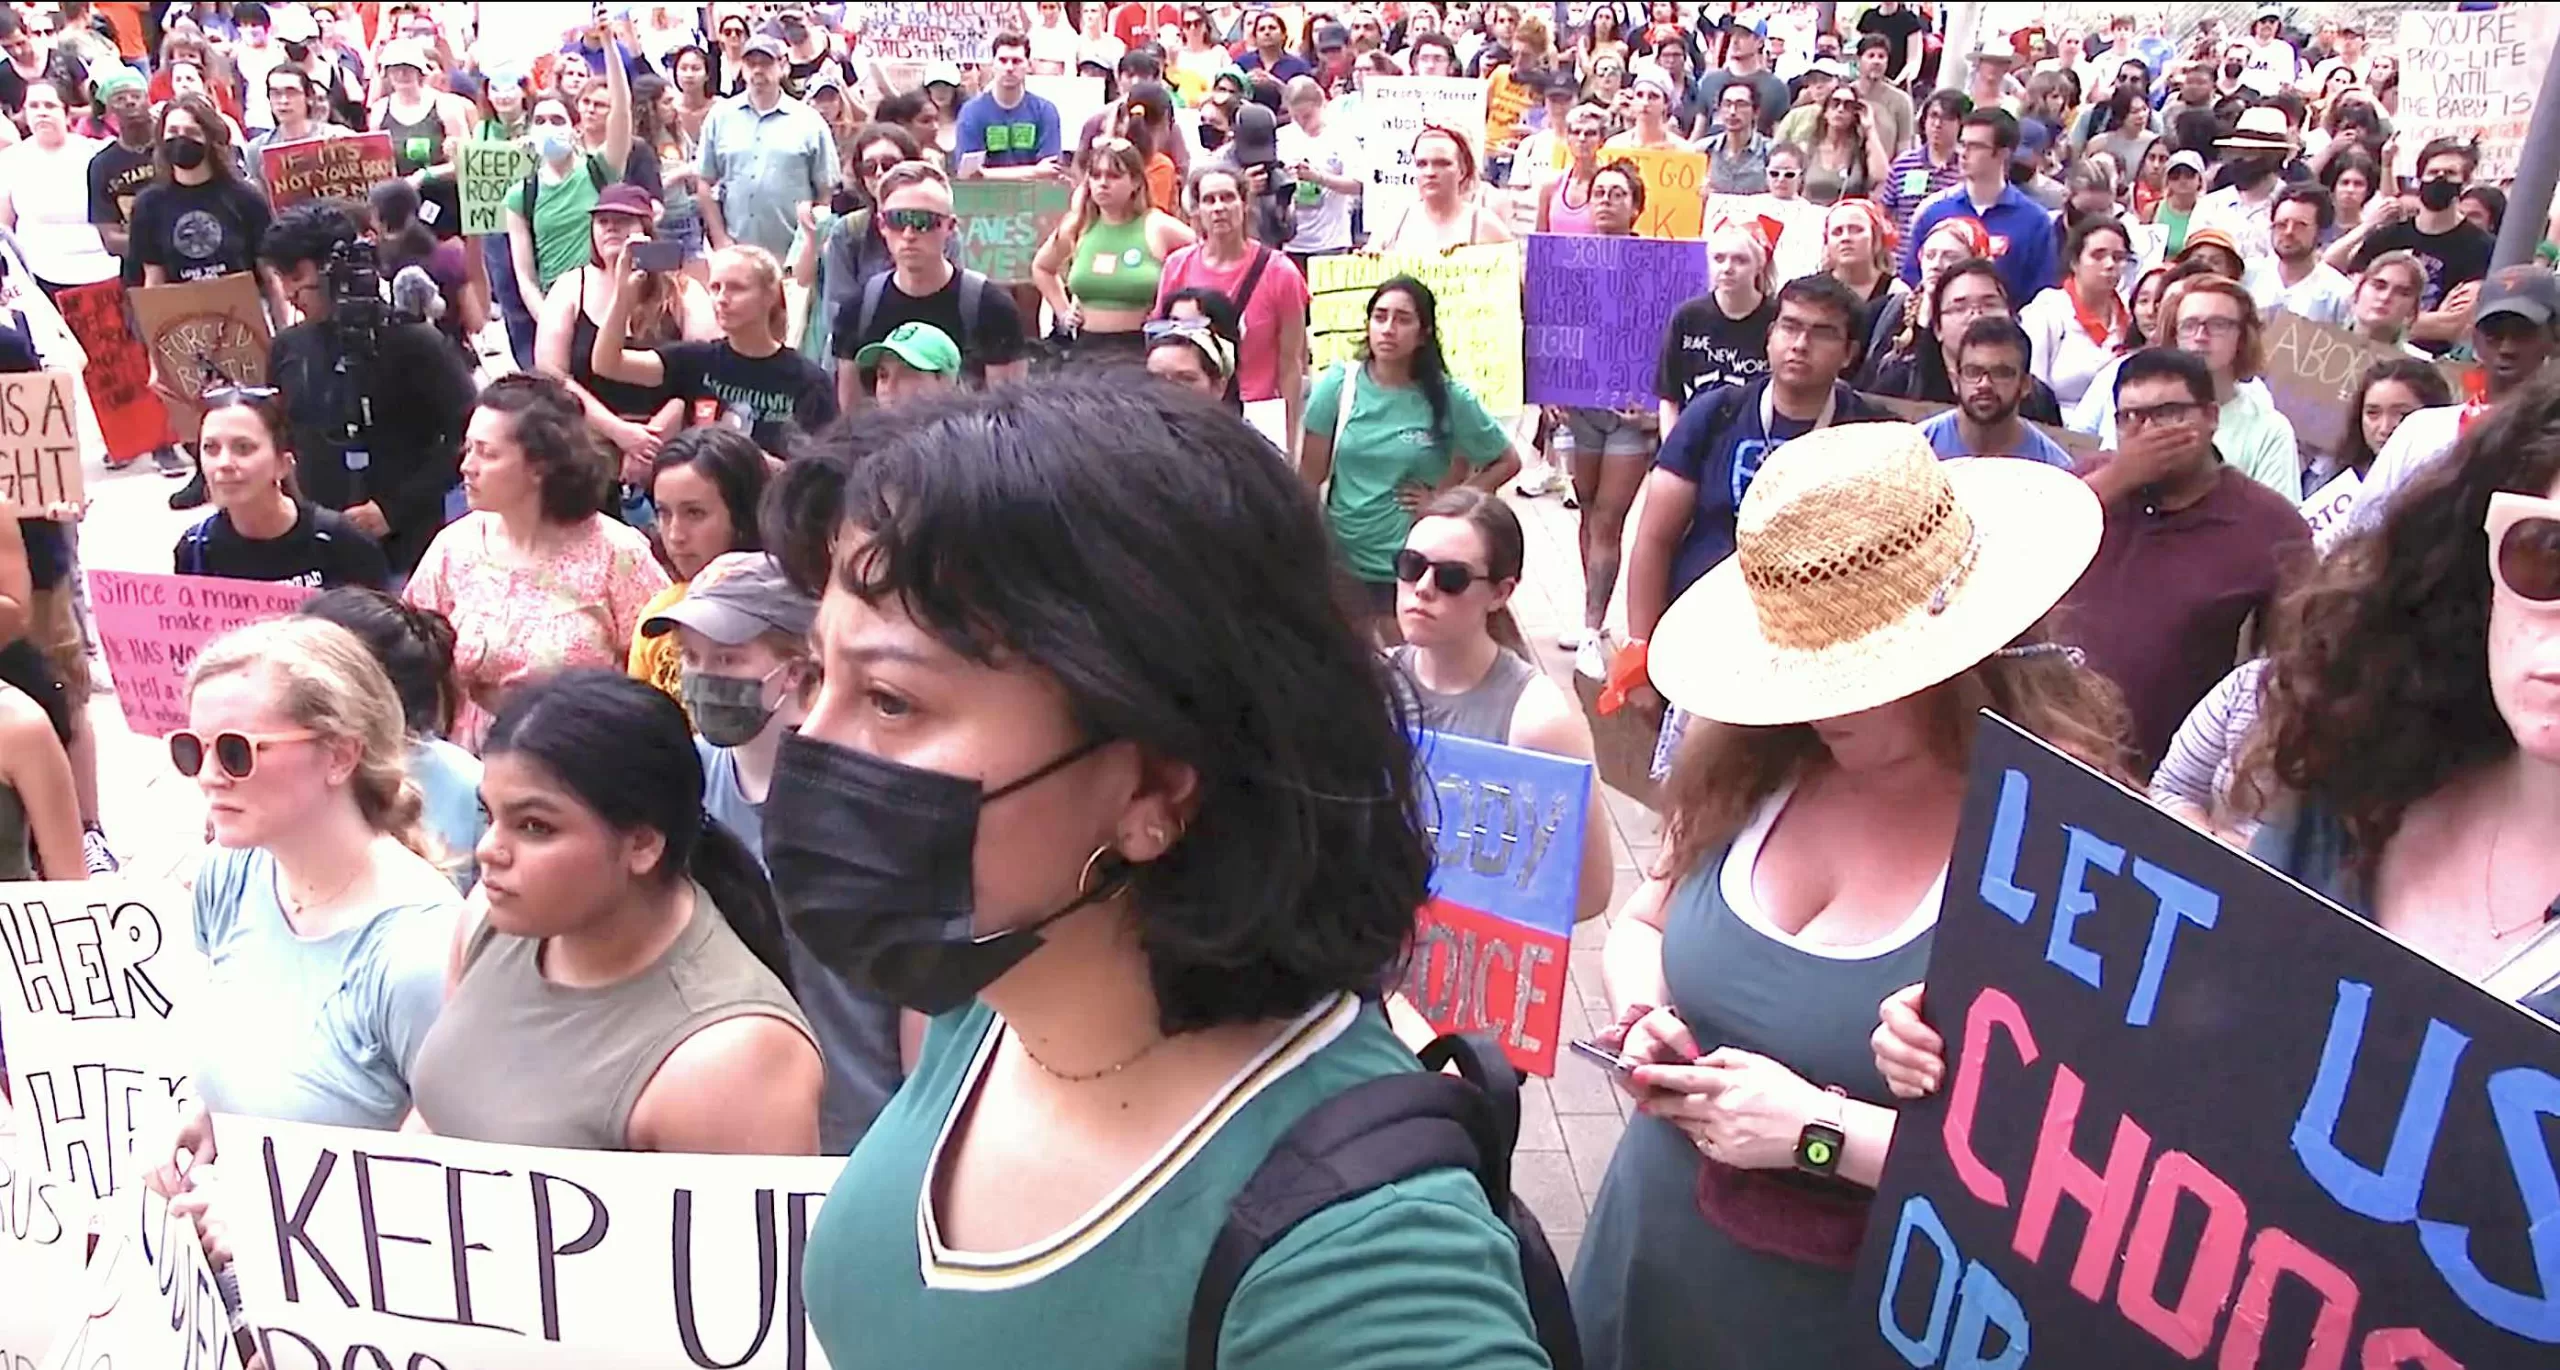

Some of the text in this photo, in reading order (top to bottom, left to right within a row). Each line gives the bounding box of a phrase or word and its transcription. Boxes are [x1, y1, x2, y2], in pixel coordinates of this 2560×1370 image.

[2407, 42, 2527, 72] PRO-LIFE
[274, 170, 313, 194] NOT
[316, 161, 362, 181] YOUR
[465, 147, 520, 178] KEEP
[1659, 159, 1695, 190] GO
[469, 206, 497, 230] MY
[962, 211, 1036, 246] AVES
[1708, 346, 1739, 363] NEW
[2266, 322, 2373, 390] ABOR
[176, 357, 257, 397] BTH
[42, 379, 72, 438] A
[0, 447, 74, 505] GHT
[97, 573, 166, 606] Since
[178, 586, 195, 608] a
[202, 591, 260, 610] man
[158, 612, 214, 632] make
[127, 637, 164, 666] HAS
[1420, 774, 1568, 891] ODY
[0, 901, 174, 1020] HER
[1404, 923, 1554, 1053] OICE
[1979, 768, 2560, 1344] LET US
[1943, 987, 2465, 1370] CHOO
[262, 1137, 610, 1343] KEEP
